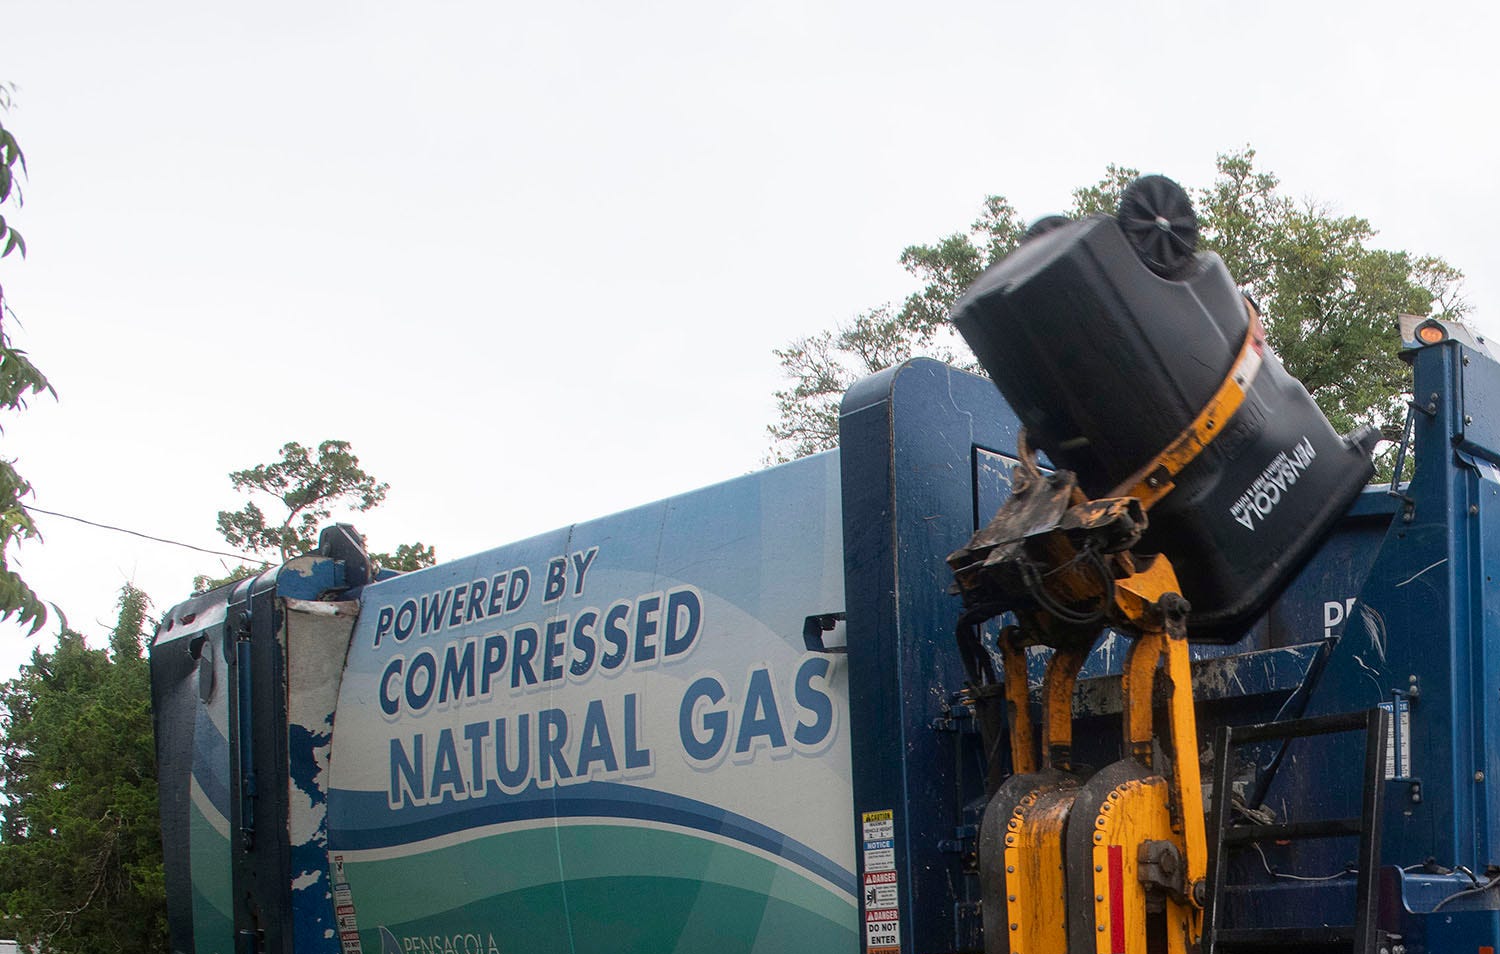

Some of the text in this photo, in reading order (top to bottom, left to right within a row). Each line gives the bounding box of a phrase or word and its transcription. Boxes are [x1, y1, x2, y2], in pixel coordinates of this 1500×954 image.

[1232, 435, 1317, 530] PENSACOLA
[374, 548, 598, 646] POWERED BY
[379, 590, 702, 715] COMPRESSED
[389, 657, 834, 804] NATURAL GAS
[867, 841, 890, 849] NOTICE
[873, 873, 896, 882] DANGER
[874, 910, 898, 920] DANGER
[869, 923, 897, 932] DO NOT
[871, 936, 896, 944] ENTER
